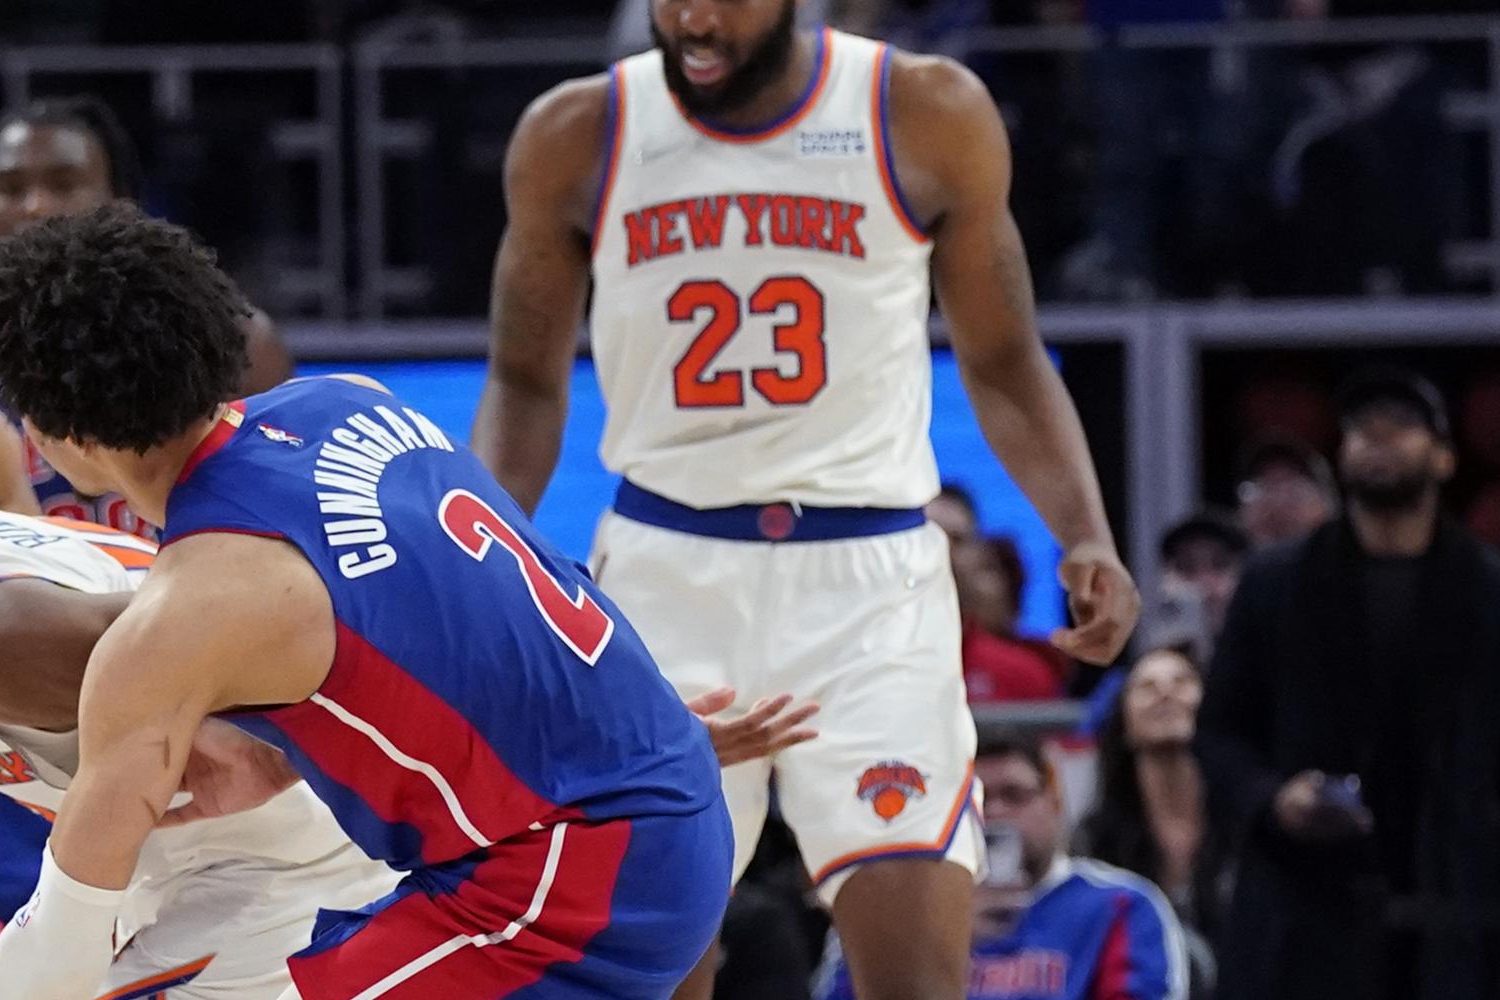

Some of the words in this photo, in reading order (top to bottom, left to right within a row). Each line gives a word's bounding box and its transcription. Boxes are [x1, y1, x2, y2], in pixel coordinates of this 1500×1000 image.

[623, 195, 731, 268] NEW
[736, 193, 866, 259] YORK
[667, 276, 827, 408] 23
[314, 404, 455, 579] CUNNINGHAM
[438, 488, 615, 668] 2
